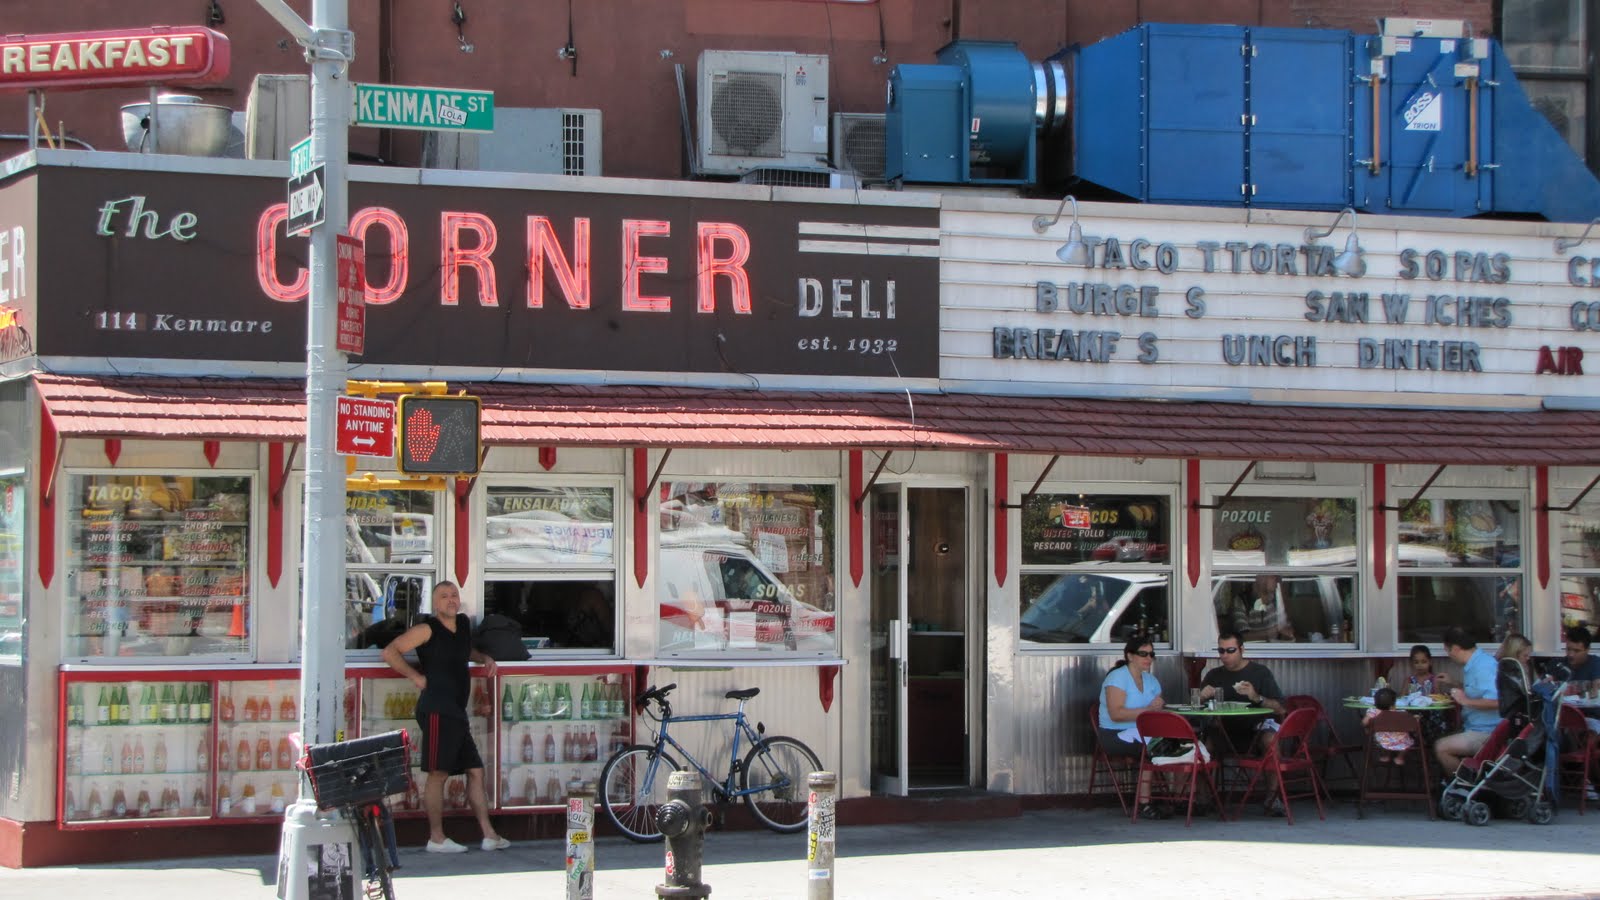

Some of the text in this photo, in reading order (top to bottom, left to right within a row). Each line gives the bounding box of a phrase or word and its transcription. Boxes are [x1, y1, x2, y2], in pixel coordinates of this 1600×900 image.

[359, 90, 488, 125] KENMARE ST
[1404, 92, 1433, 123] BOSS
[442, 109, 463, 122] LOLA
[1413, 122, 1437, 130] TRION
[293, 184, 321, 216] ONE WAY
[95, 196, 198, 241] the
[257, 202, 752, 314] CORNER
[1081, 236, 1179, 275] TACO
[1398, 248, 1511, 284] SOPAS
[798, 278, 896, 319] DELI
[100, 312, 273, 333] 114 Kenmare
[798, 336, 898, 354] est. 1932
[1223, 334, 1317, 367] UNCH
[1358, 337, 1482, 372] DINNER
[1536, 345, 1584, 375] AIR
[340, 404, 391, 419] NO STANDING
[346, 419, 385, 433] ANYTIME
[88, 486, 145, 501] TACOS
[503, 497, 589, 511] ENSALADAS
[1221, 510, 1272, 523] POZOLE
[1078, 529, 1104, 538] POLLO
[1034, 542, 1072, 550] PESCADO
[756, 583, 806, 597] SOAS
[215, 598, 244, 607] CHAD
